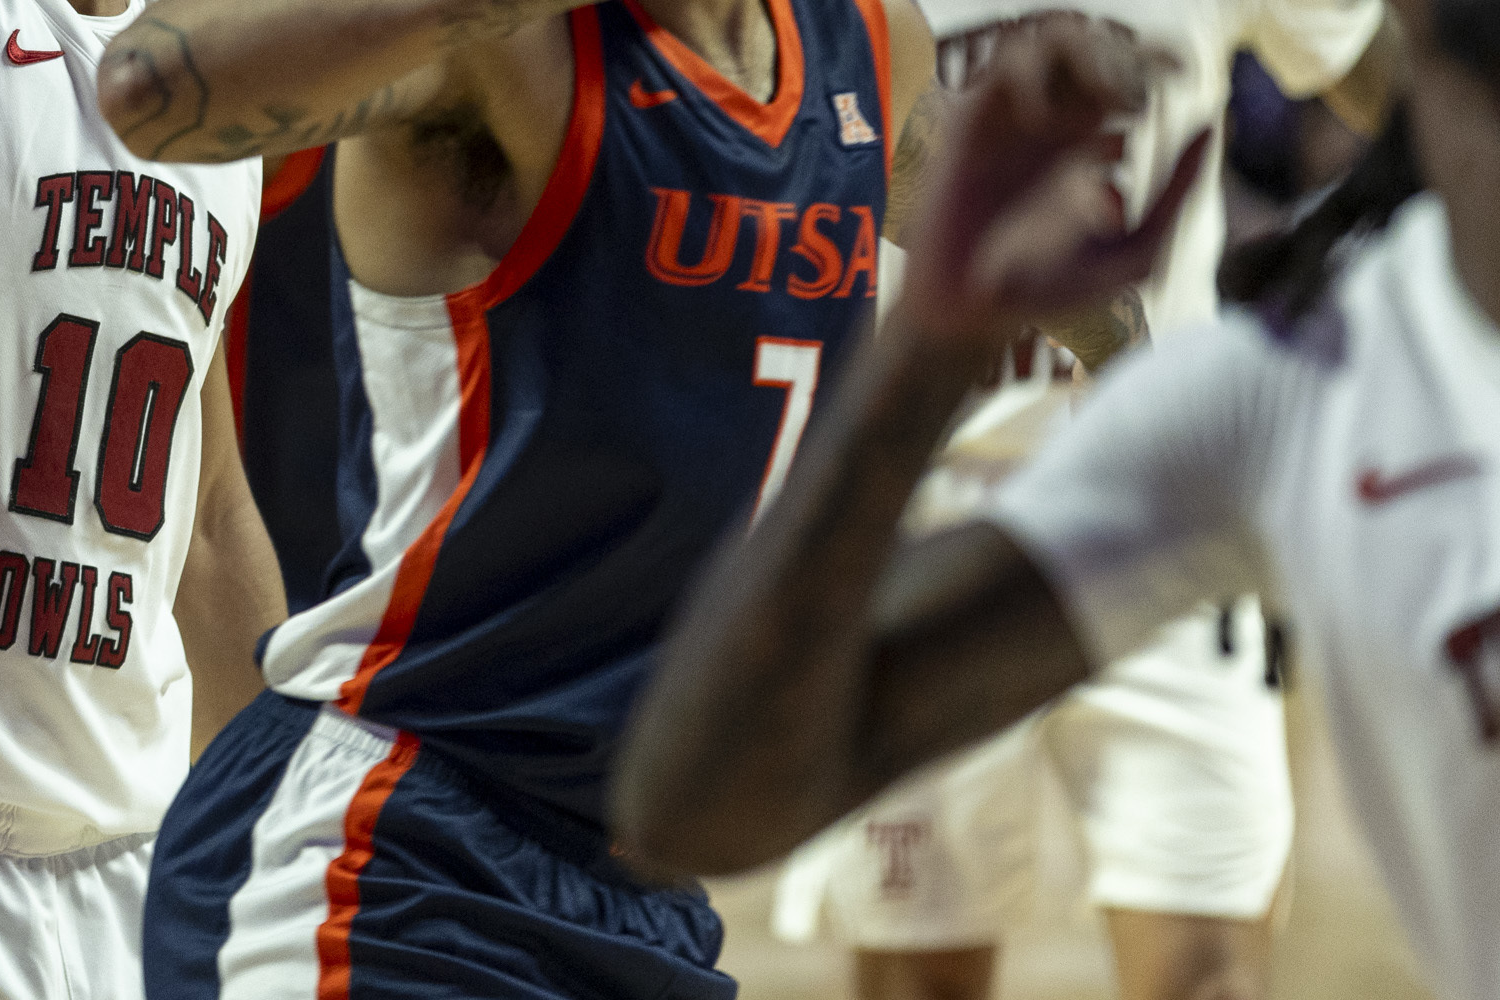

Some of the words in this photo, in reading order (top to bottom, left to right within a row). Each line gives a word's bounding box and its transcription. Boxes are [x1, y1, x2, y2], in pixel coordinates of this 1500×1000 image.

[32, 169, 228, 327] TEMPLE
[645, 187, 878, 299] UTSA
[8, 312, 195, 543] 10
[752, 335, 825, 535] 7
